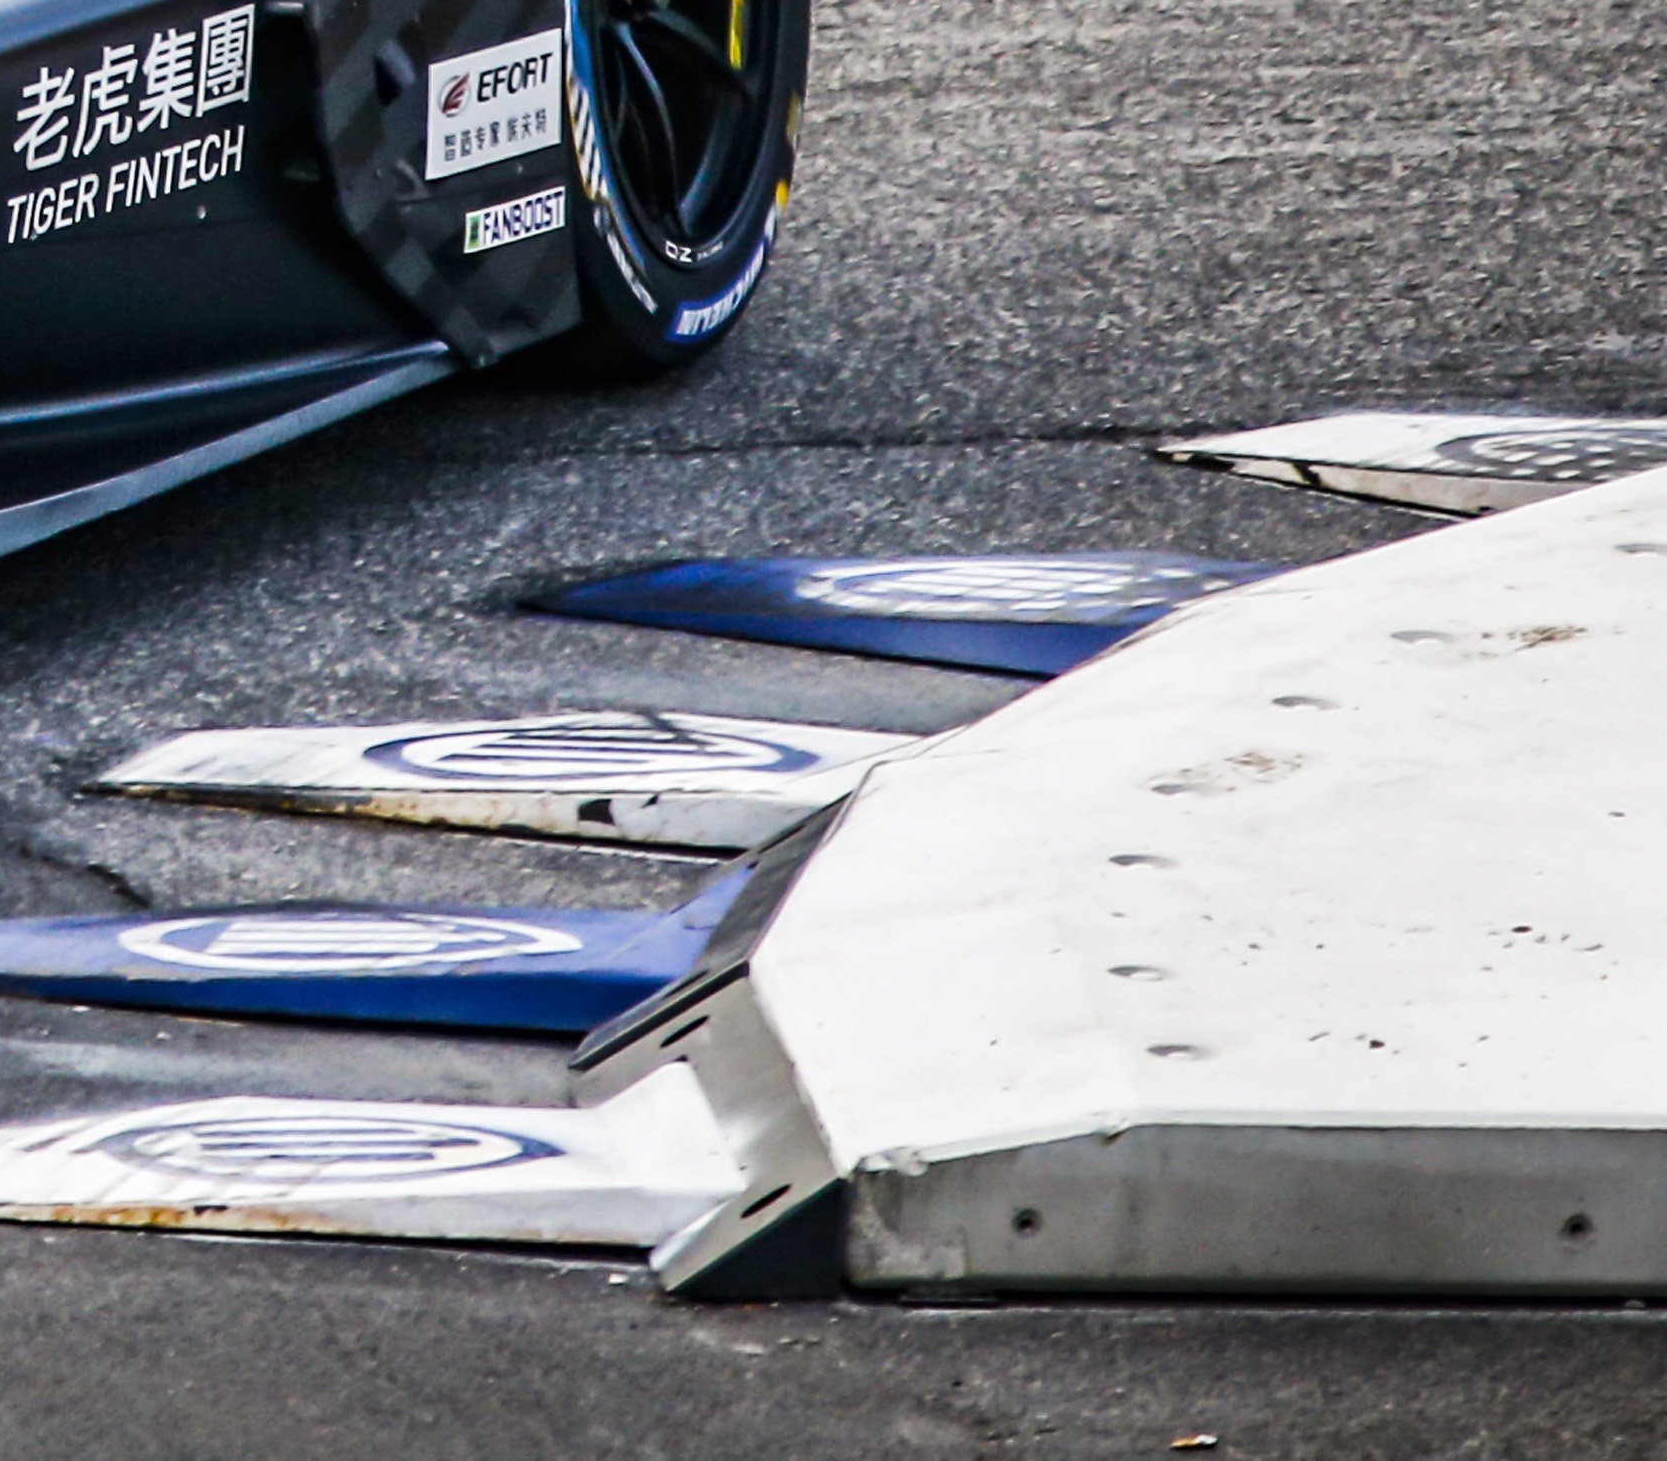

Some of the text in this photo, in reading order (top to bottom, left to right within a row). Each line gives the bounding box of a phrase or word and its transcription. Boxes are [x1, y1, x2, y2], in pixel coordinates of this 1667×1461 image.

[12, 2, 256, 172] 老虎集團
[476, 52, 554, 104] EFORT
[7, 124, 245, 244] TIGER FINTECH
[481, 190, 564, 246] FANBOOST
